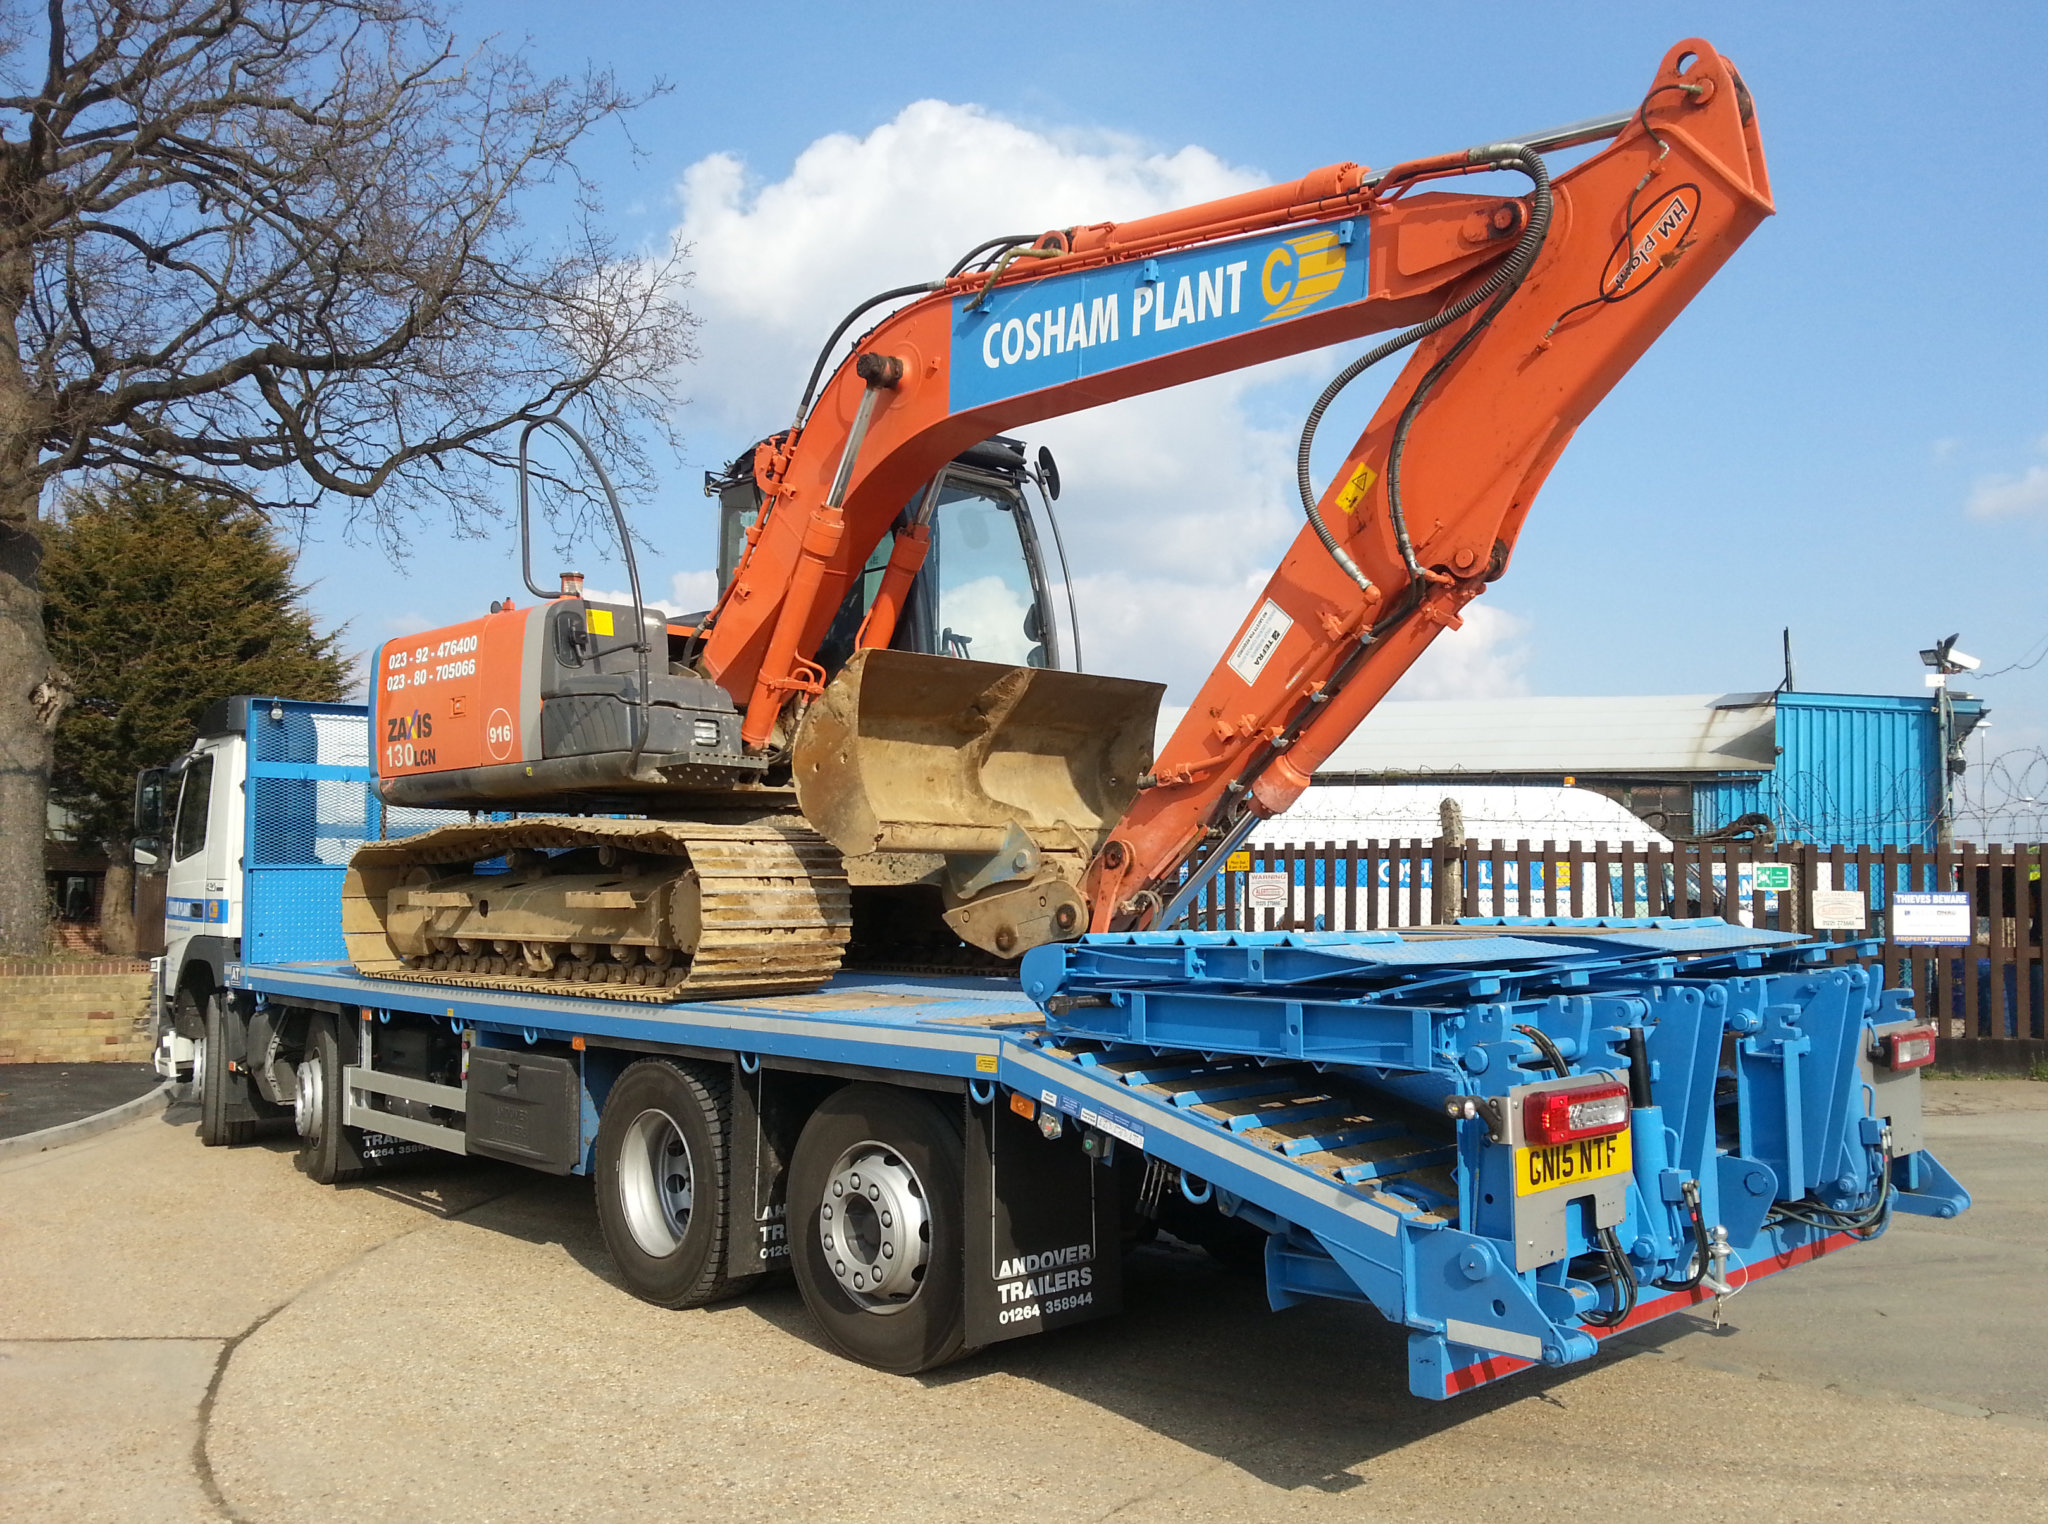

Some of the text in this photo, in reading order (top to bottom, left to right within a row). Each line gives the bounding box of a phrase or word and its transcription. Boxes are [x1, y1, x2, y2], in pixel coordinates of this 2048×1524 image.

[1657, 196, 1688, 238] HM
[982, 293, 1119, 369] COSHAM
[1132, 260, 1248, 337] PLANT
[388, 652, 407, 670] 023
[415, 646, 429, 664] 92
[437, 635, 478, 659] 476400
[1254, 639, 1273, 666] TEFRA
[387, 673, 405, 691] 023
[414, 669, 427, 686] 80
[436, 659, 476, 682] 705066
[387, 709, 432, 742] ZAXIS
[489, 725, 511, 744] 916
[1896, 894, 1967, 904] THIEVES BEWARE
[231, 967, 240, 980] AT
[363, 1147, 395, 1158] 01264
[1529, 1134, 1617, 1186] GN15 NTF
[998, 1244, 1091, 1278] ANDOVER
[997, 1267, 1093, 1304] TRAILERS
[999, 1292, 1093, 1325] 01264 358944
